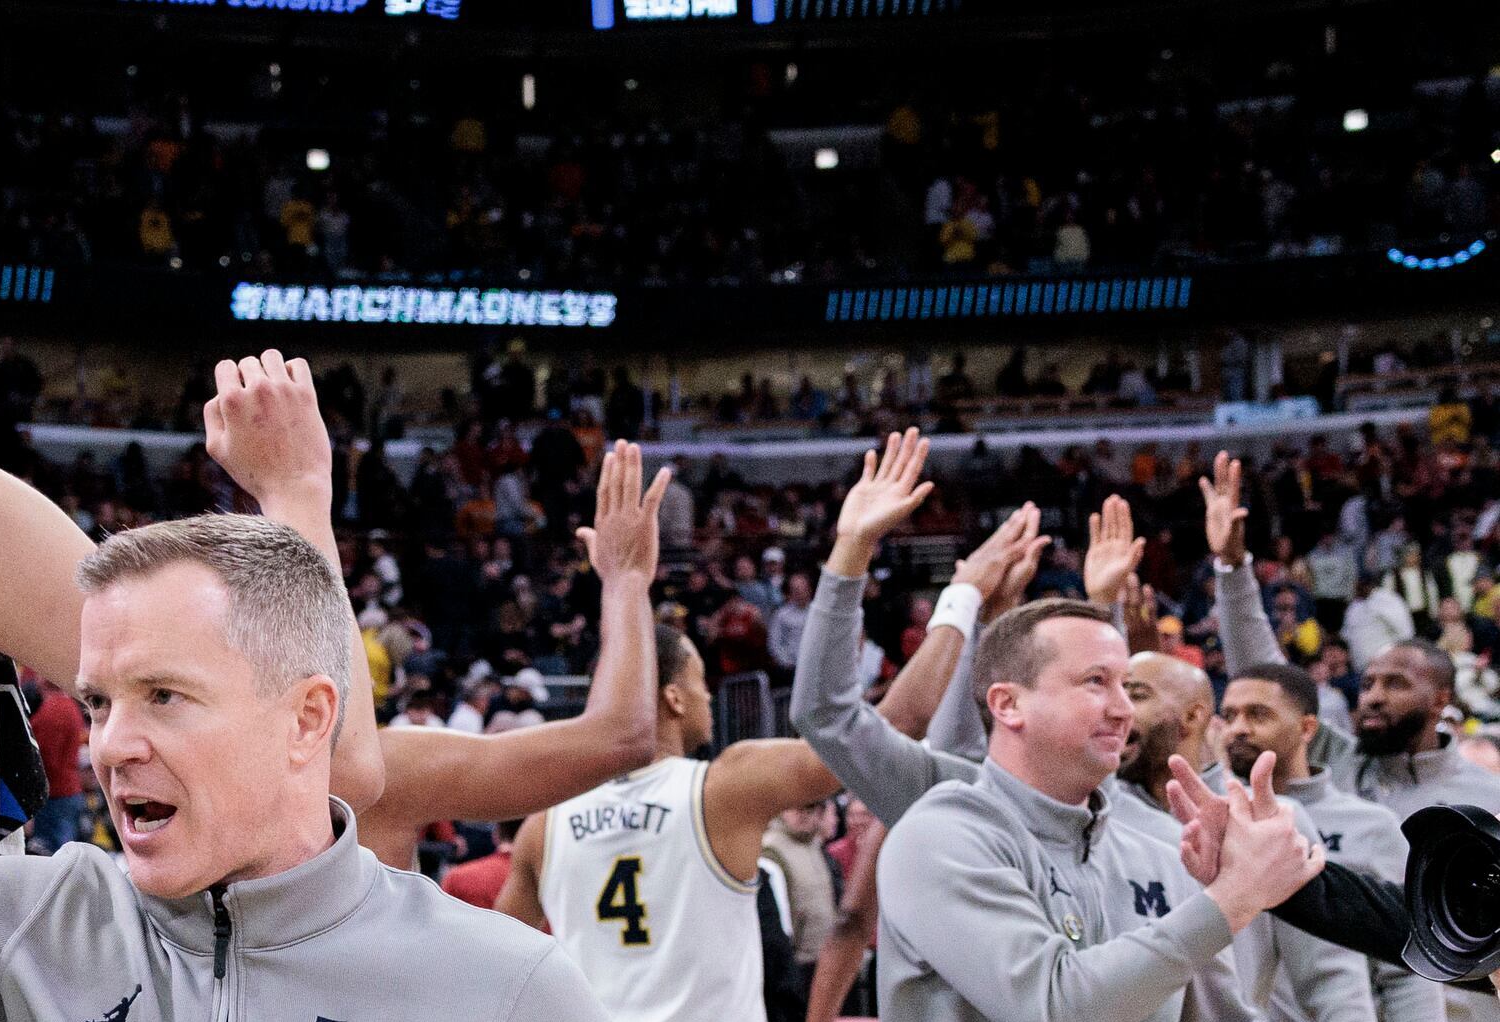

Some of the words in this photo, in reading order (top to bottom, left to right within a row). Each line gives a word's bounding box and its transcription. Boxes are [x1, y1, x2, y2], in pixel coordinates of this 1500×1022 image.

[231, 282, 617, 327] #MARCHMADNESS
[569, 803, 671, 841] BURNETT
[597, 855, 650, 946] 4
